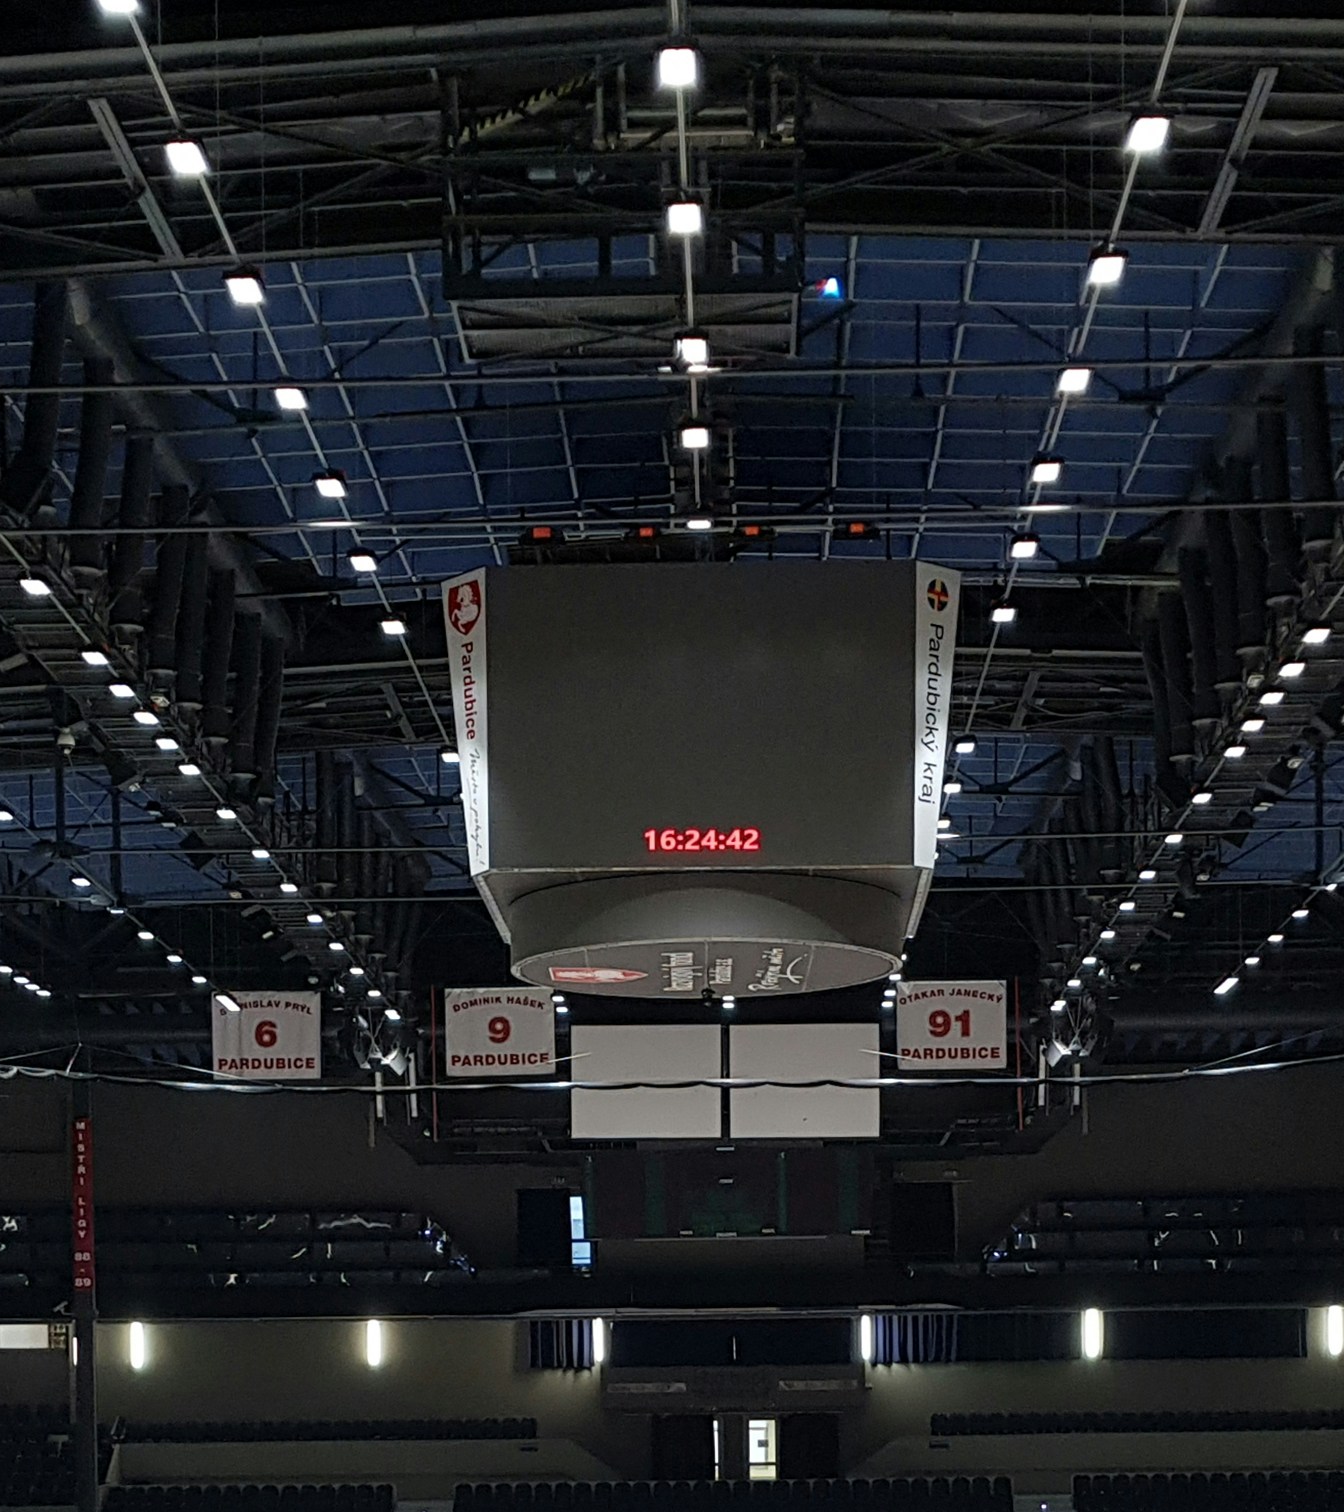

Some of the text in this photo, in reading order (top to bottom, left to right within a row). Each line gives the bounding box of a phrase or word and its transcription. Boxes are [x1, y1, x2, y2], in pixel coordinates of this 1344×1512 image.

[460, 642, 476, 741] Pardubice
[918, 622, 944, 804] Pardubický kraj
[644, 828, 760, 852] 16:24:42
[452, 994, 546, 1013] DOMINIK HAŠEK
[899, 988, 1003, 1005] OTAKAR JANECKÝ
[254, 1020, 278, 1048] 6
[488, 1016, 511, 1043] 9
[929, 1009, 971, 1038] 91
[218, 1057, 316, 1071] PARDUBICE
[451, 1052, 550, 1067] PARDUBICE
[901, 1047, 1001, 1060] PARDUBICE
[76, 1196, 87, 1239] LIGY
